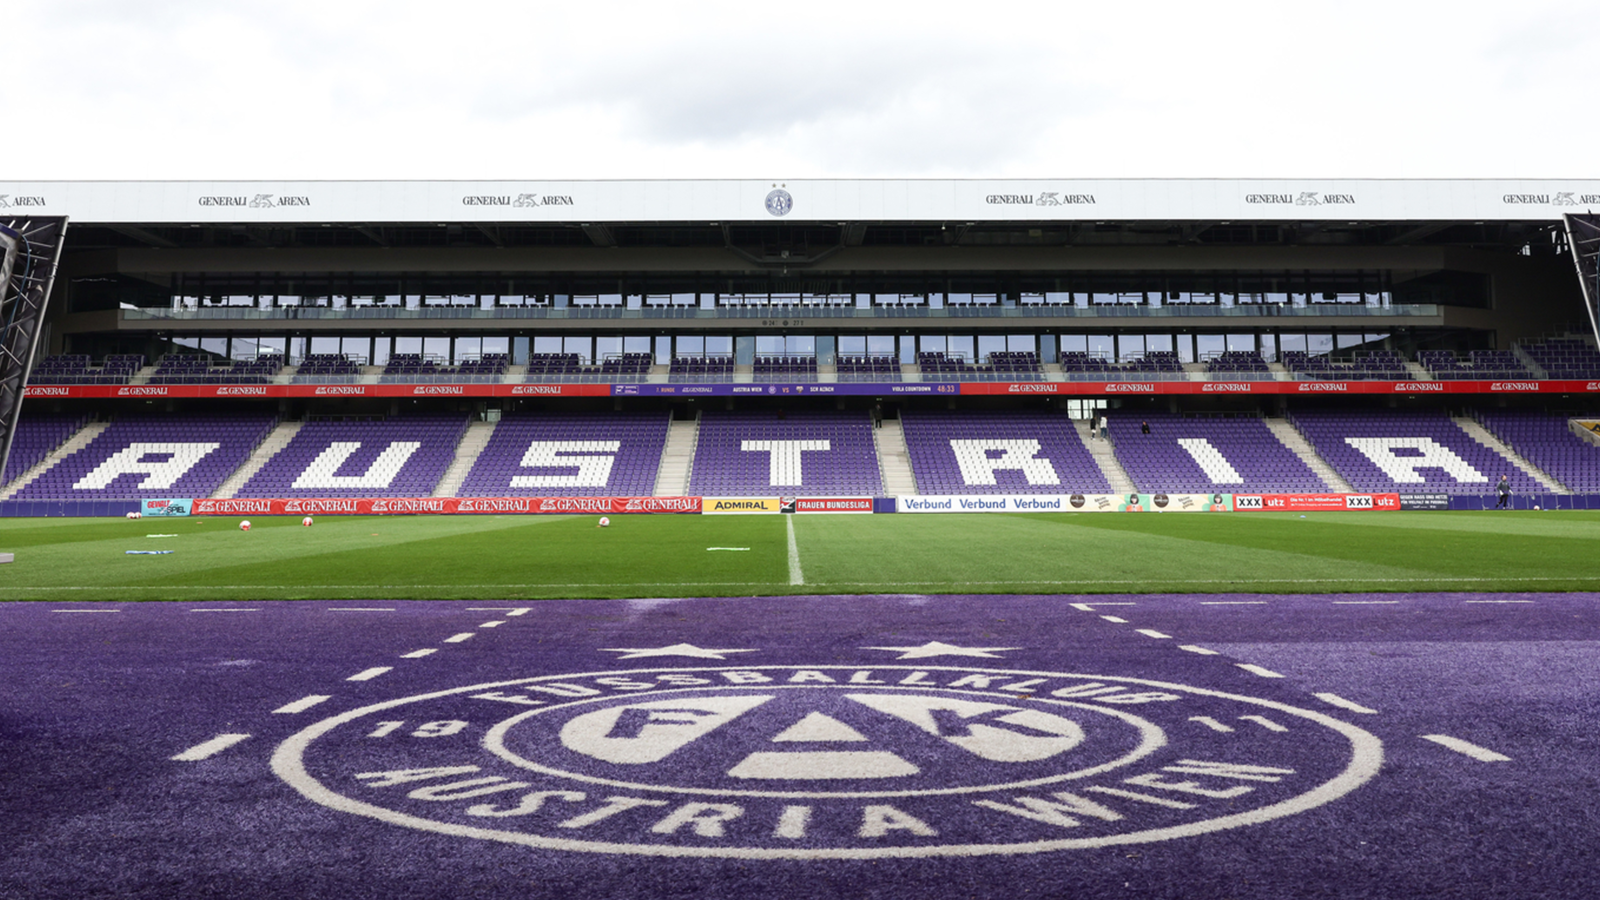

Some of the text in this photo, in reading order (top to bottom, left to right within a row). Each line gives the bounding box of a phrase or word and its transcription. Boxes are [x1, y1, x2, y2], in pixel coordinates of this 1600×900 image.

[12, 196, 46, 206] ARENA
[198, 195, 310, 206] GENERALI ARENA
[462, 195, 573, 206] GENERALI ARENA
[985, 194, 1096, 204] GENERALI ARENA
[1244, 194, 1355, 204] GENERALI ARENA
[1502, 194, 1550, 204] GENERALI
[31, 387, 69, 395] GENERALI
[130, 387, 168, 395] GENERALI
[228, 387, 267, 395] GENERALI
[327, 386, 365, 395] GENERALI
[425, 386, 463, 394] GENERALI
[523, 386, 561, 394] GENERALI
[1020, 384, 1058, 392] GENERALI
[1117, 384, 1155, 392] GENERALI
[1213, 383, 1251, 391] GENERALI
[1310, 383, 1347, 391] GENERALI
[1406, 382, 1443, 391] GENERALI
[1502, 382, 1540, 391] GENERALI
[216, 500, 271, 512] GENERALI
[302, 500, 358, 511] GENERALI
[388, 500, 444, 511] GENERALI
[475, 500, 530, 511] GENERALI
[557, 499, 612, 510] GENERALI
[642, 499, 698, 510] GENERALI
[714, 501, 768, 510] ADMIRAL
[798, 501, 870, 509] FRAUEN BUNDESLIGA
[904, 498, 1061, 509] Verbund Verbund Verbund
[1187, 714, 1289, 732] 11
[366, 719, 470, 738] 19
[970, 759, 1296, 827] WIEN
[356, 764, 938, 839] AUSTRIA
